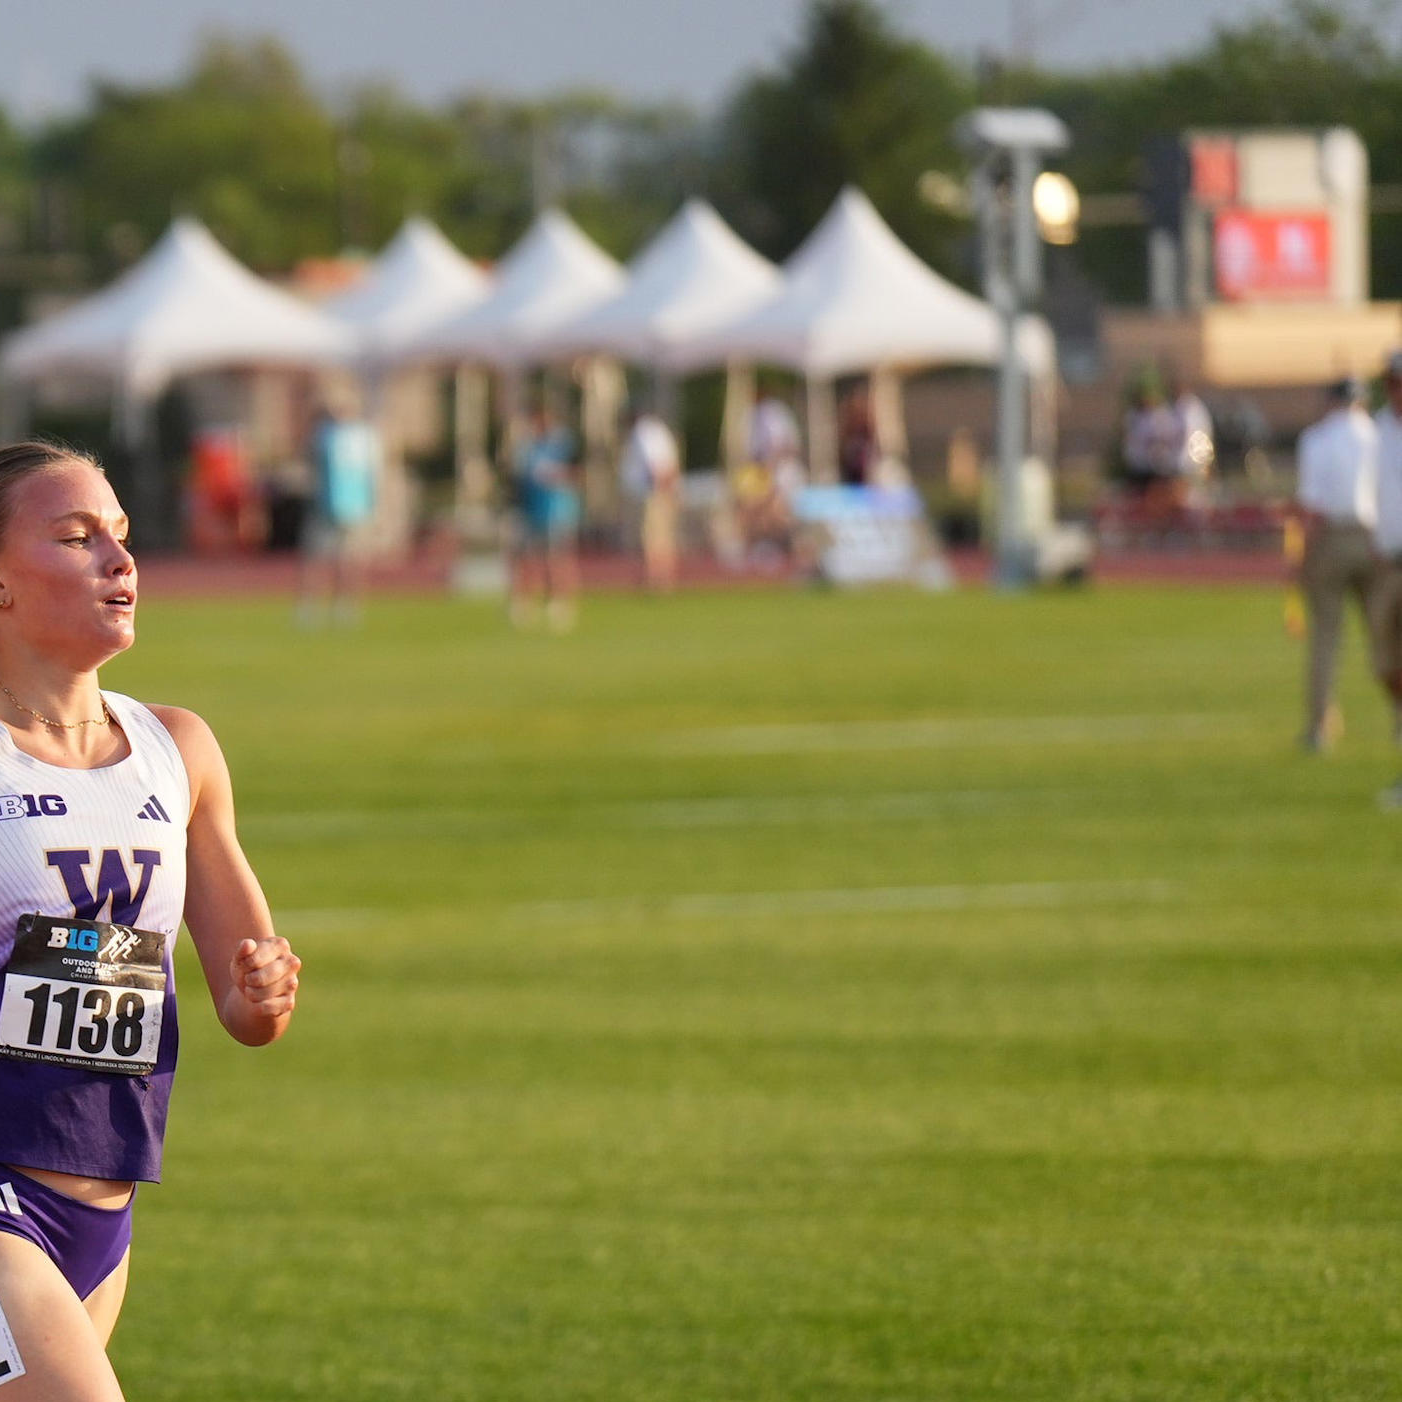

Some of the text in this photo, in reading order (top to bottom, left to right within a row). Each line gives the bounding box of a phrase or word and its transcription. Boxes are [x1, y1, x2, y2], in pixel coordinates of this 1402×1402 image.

[43, 846, 163, 927] W
[62, 957, 101, 968] OUTDOOR
[76, 966, 93, 974] AND
[24, 983, 145, 1057] 1138
